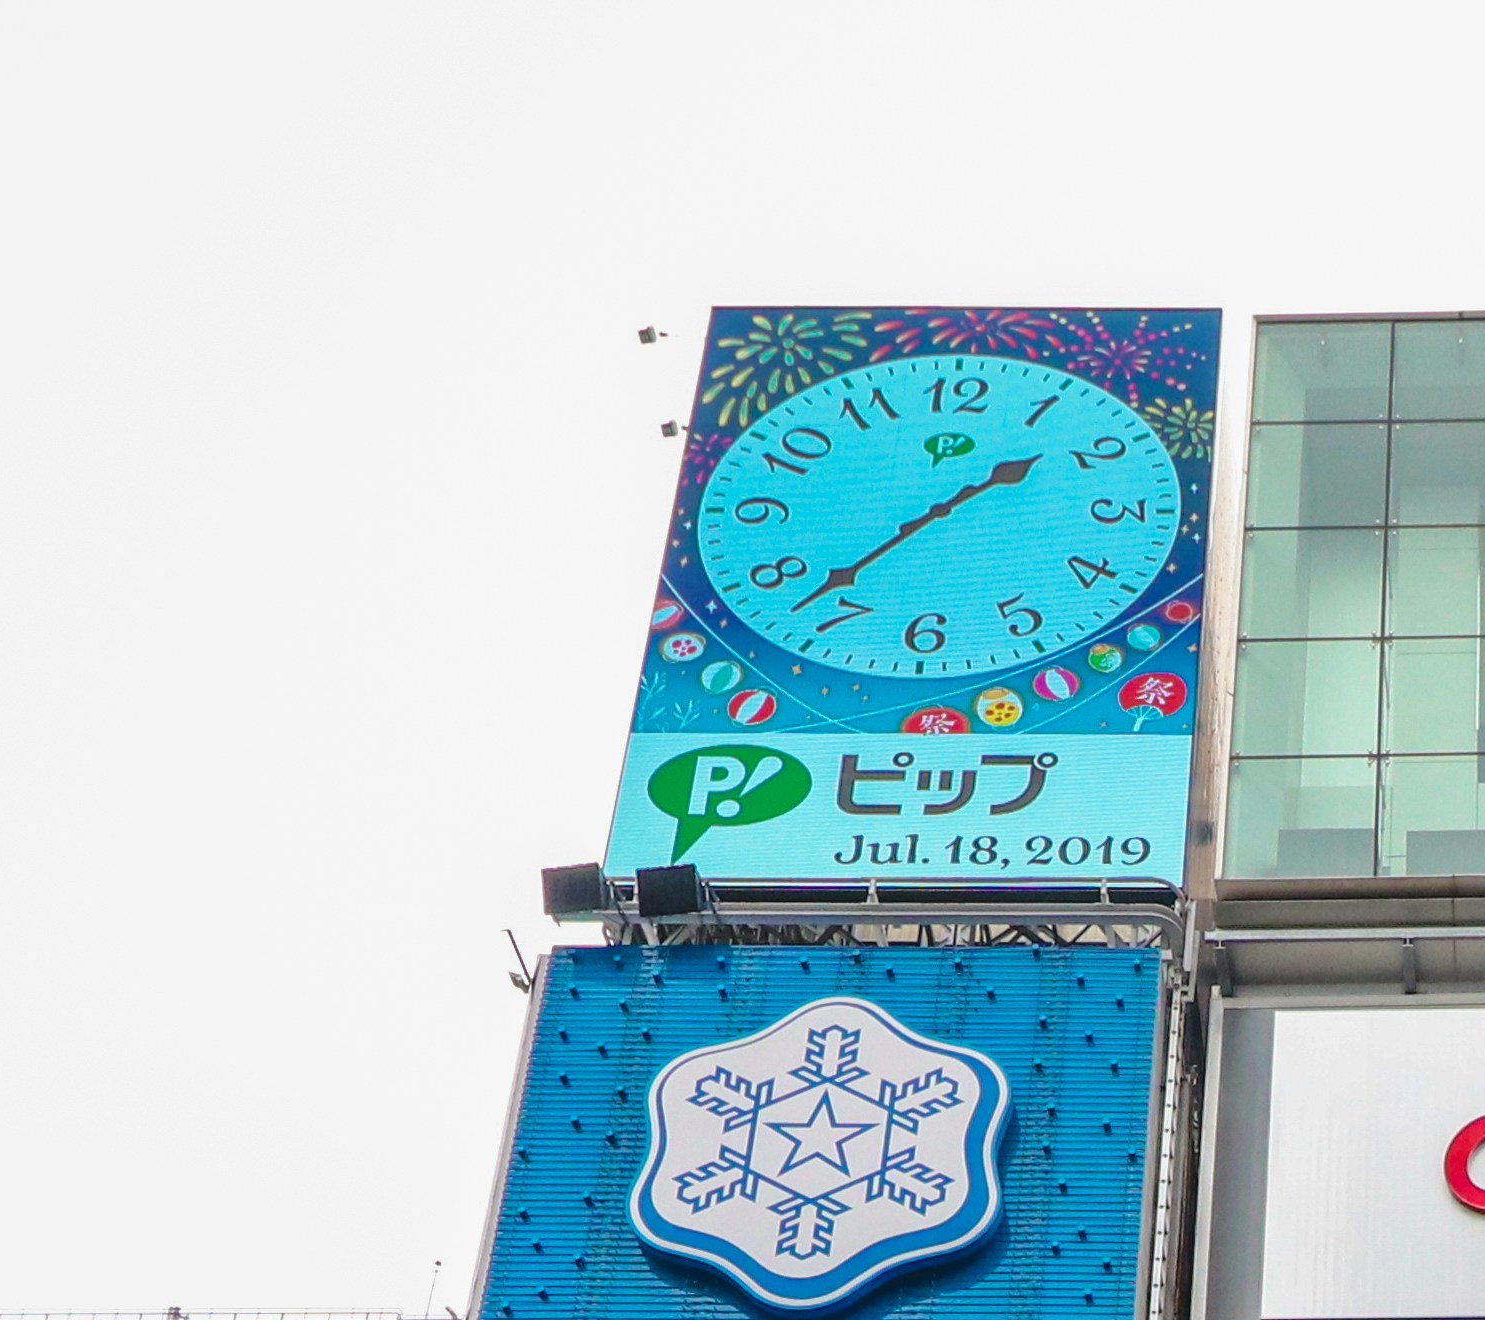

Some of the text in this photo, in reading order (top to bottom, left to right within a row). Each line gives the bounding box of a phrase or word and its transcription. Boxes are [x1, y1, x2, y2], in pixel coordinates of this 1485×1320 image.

[838, 387, 902, 431] 11
[923, 376, 990, 415] 12
[1024, 395, 1061, 429] 1
[763, 427, 833, 477] 10
[1068, 436, 1127, 471] 2
[734, 496, 790, 525] 9
[1090, 499, 1147, 526] 3
[749, 555, 808, 590] 8
[1067, 554, 1119, 590] 4
[816, 594, 875, 634] 7
[904, 611, 947, 654] 6
[996, 592, 1043, 637] 5
[836, 752, 1060, 818] ピップ
[834, 834, 1153, 869] Jul. 18, 2019
